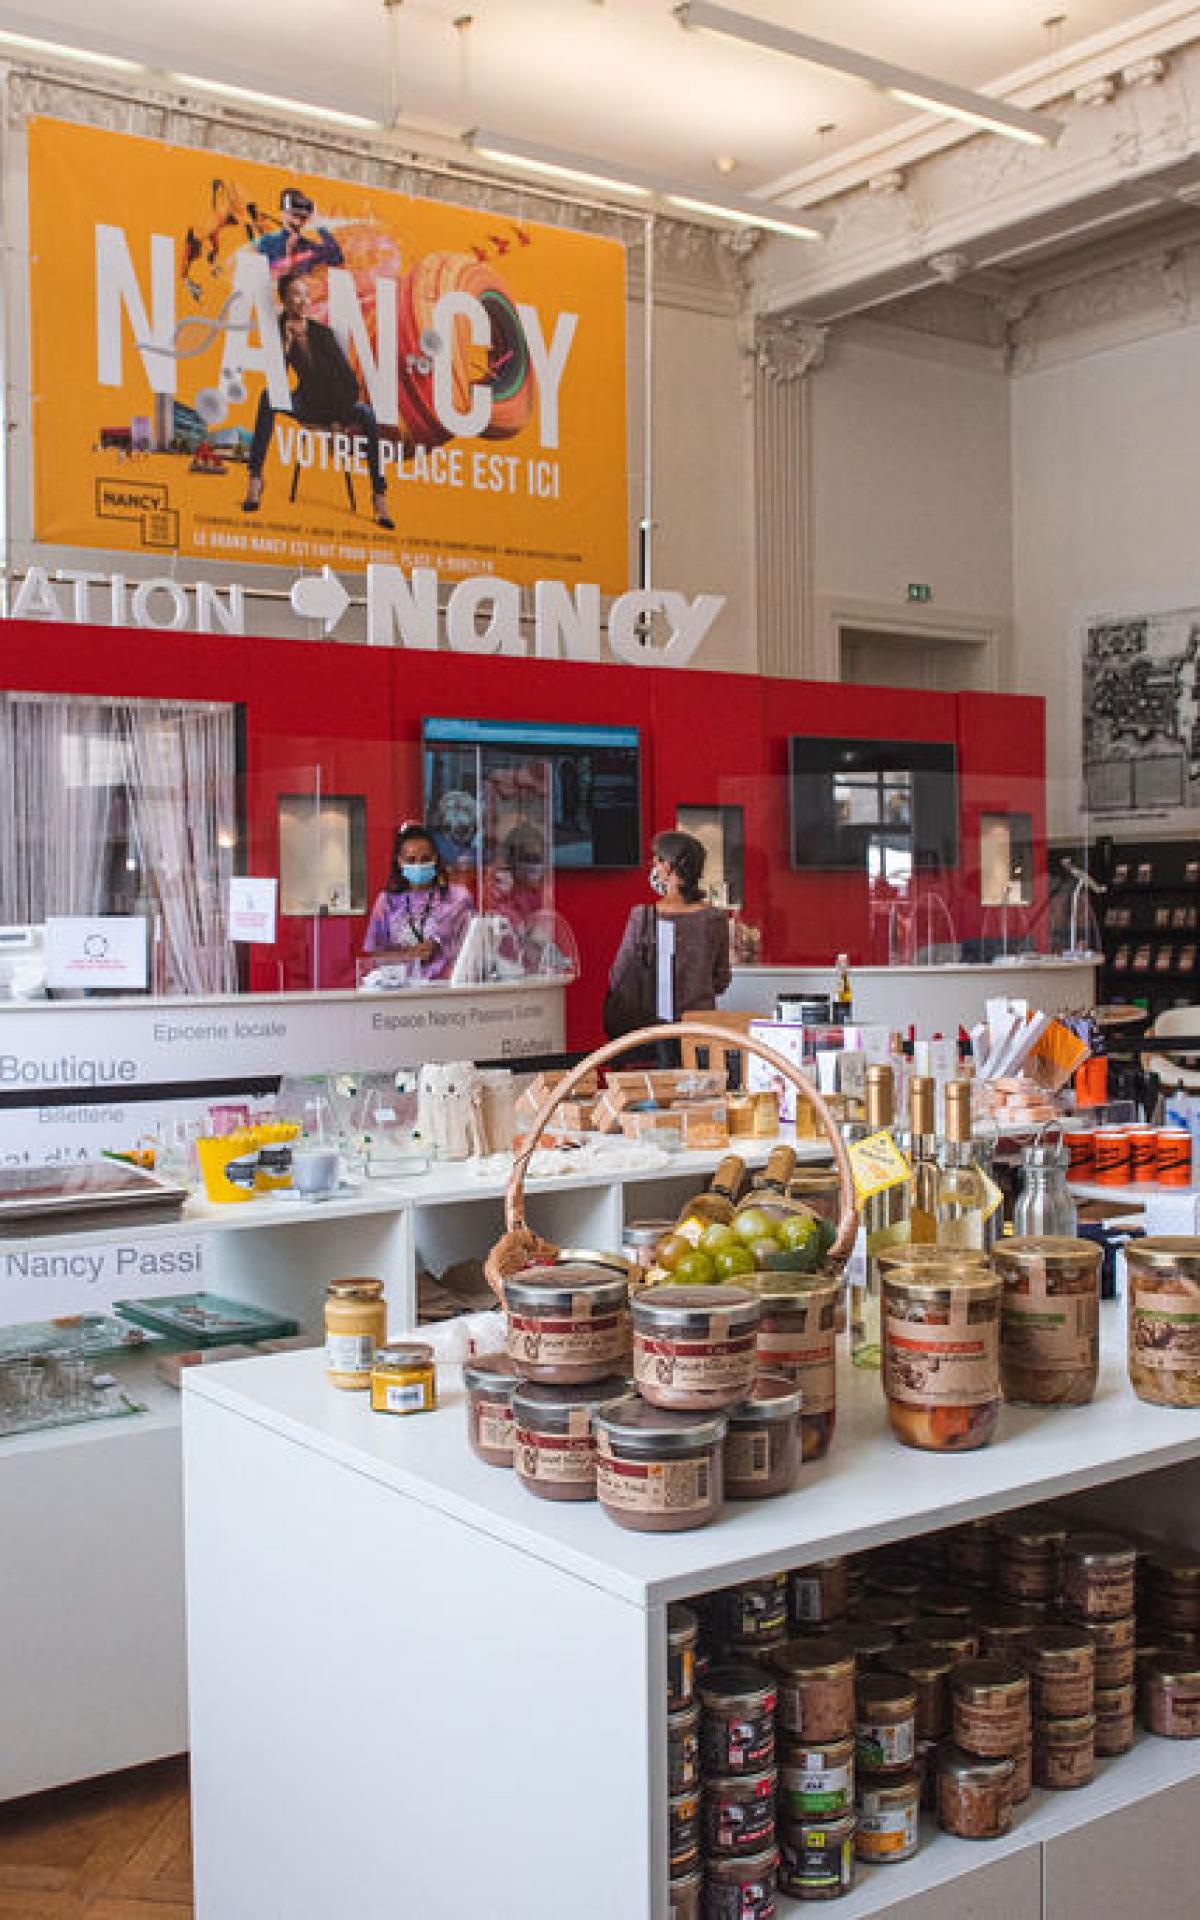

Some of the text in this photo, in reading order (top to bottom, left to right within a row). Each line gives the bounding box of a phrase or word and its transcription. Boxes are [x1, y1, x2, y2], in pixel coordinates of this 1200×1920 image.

[94, 223, 579, 450] NANCY
[275, 425, 560, 499] VOTRE PLACE EST ICI
[103, 492, 160, 511] NANCY
[10, 566, 245, 634] ATION
[153, 1020, 287, 1043] Epicerie locale
[0, 1055, 138, 1085] Boutique
[8, 1244, 202, 1282] Nancy Passi
